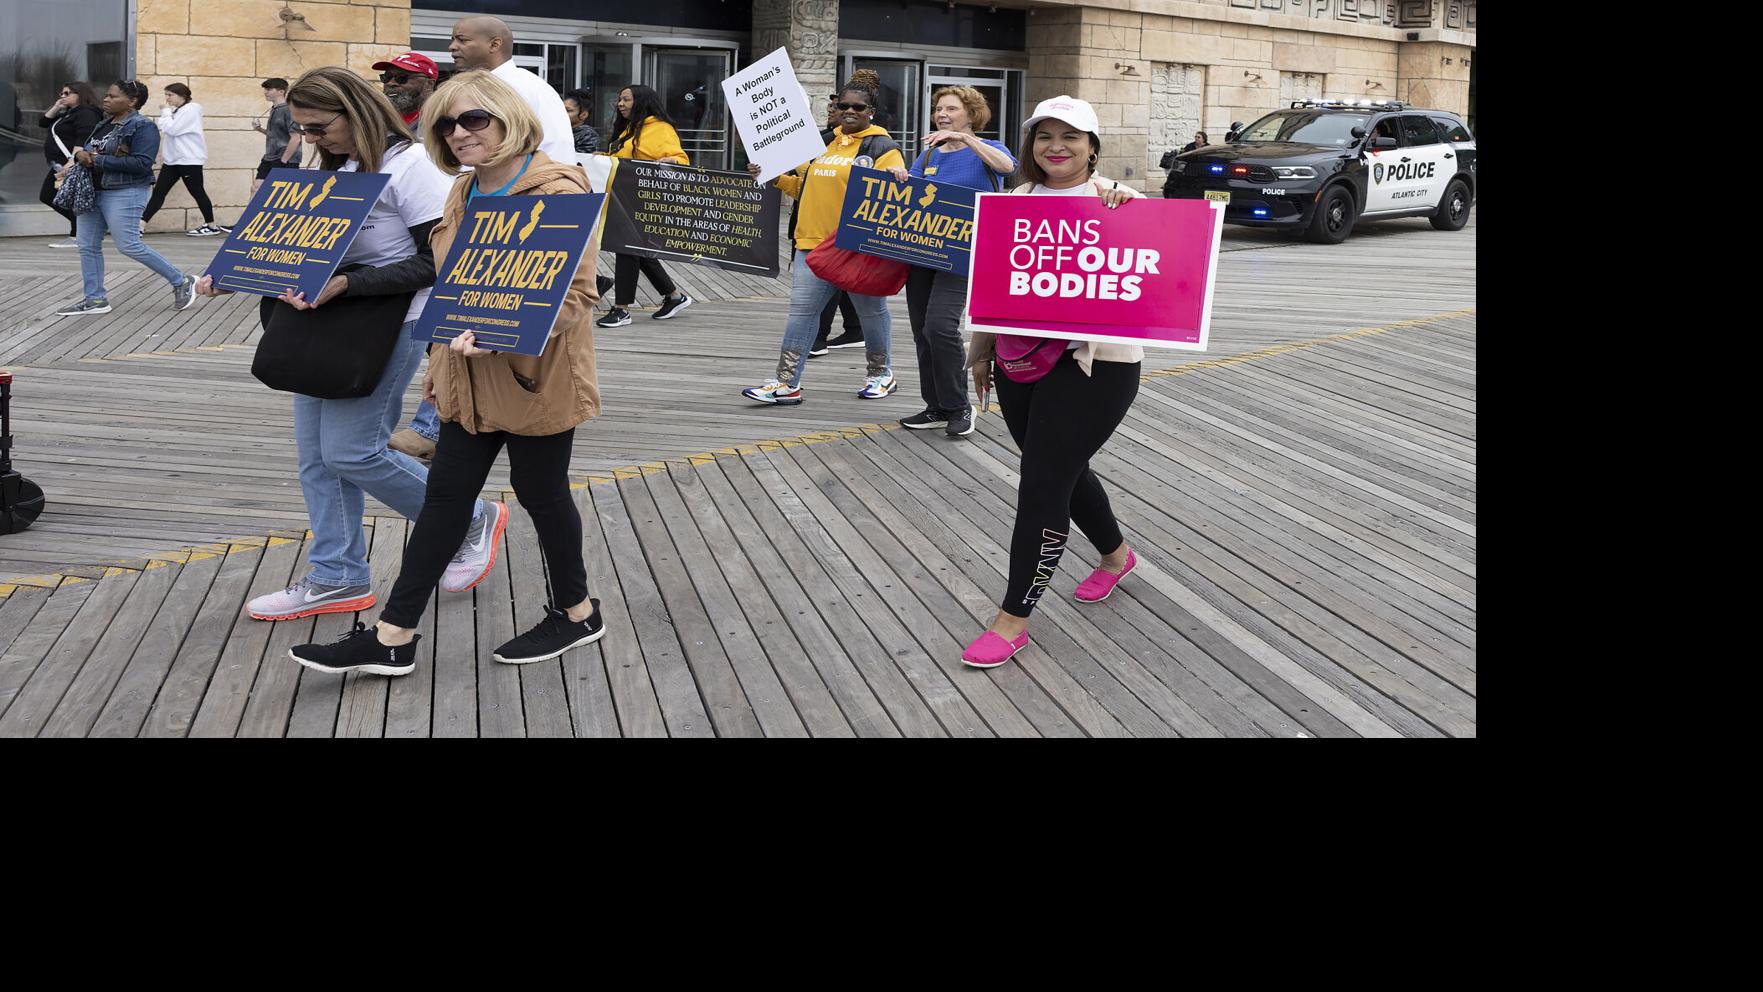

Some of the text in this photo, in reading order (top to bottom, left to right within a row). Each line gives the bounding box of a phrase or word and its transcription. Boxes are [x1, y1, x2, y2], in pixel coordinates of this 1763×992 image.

[735, 66, 781, 97] A Woman's
[751, 86, 774, 103] Body
[750, 112, 758, 120] is
[759, 99, 778, 116] NOT
[756, 109, 791, 134] Political
[753, 118, 805, 151] Battleground
[636, 167, 766, 190] OUR MISSION IS TO ADVOCATE ON
[813, 168, 837, 177] PARIS
[1386, 161, 1435, 182] POLICE
[263, 180, 314, 210] TIM
[638, 179, 762, 201] BEHALF OF BLACK WOMEN AND
[638, 190, 762, 213] GIRLS TO PROMOTE LEADERSHIP
[862, 176, 913, 205] TIM
[1262, 187, 1286, 196] POLICE
[1391, 189, 1428, 200] ATLANTIC CITY
[644, 202, 754, 224] DEVELOPMENT AND GENDER
[852, 200, 974, 242] ALEXANDER
[236, 212, 351, 250] ALEXANDER
[468, 210, 520, 245] TIM
[634, 212, 762, 238] EQUITY IN THE AREAS OF HEALTH,
[644, 224, 752, 248] EDUCATION AND ECONOMIC
[1013, 218, 1101, 245] BANS
[665, 240, 728, 256] EMPOWERMENT.
[876, 226, 944, 249] FOR WOMEN
[246, 246, 306, 266] FOR WOMEN
[1010, 244, 1160, 275] OFF OUR
[445, 248, 568, 290] ALEXANDER
[1009, 272, 1143, 302] BODIES
[458, 291, 524, 311] FOR WOMEN
